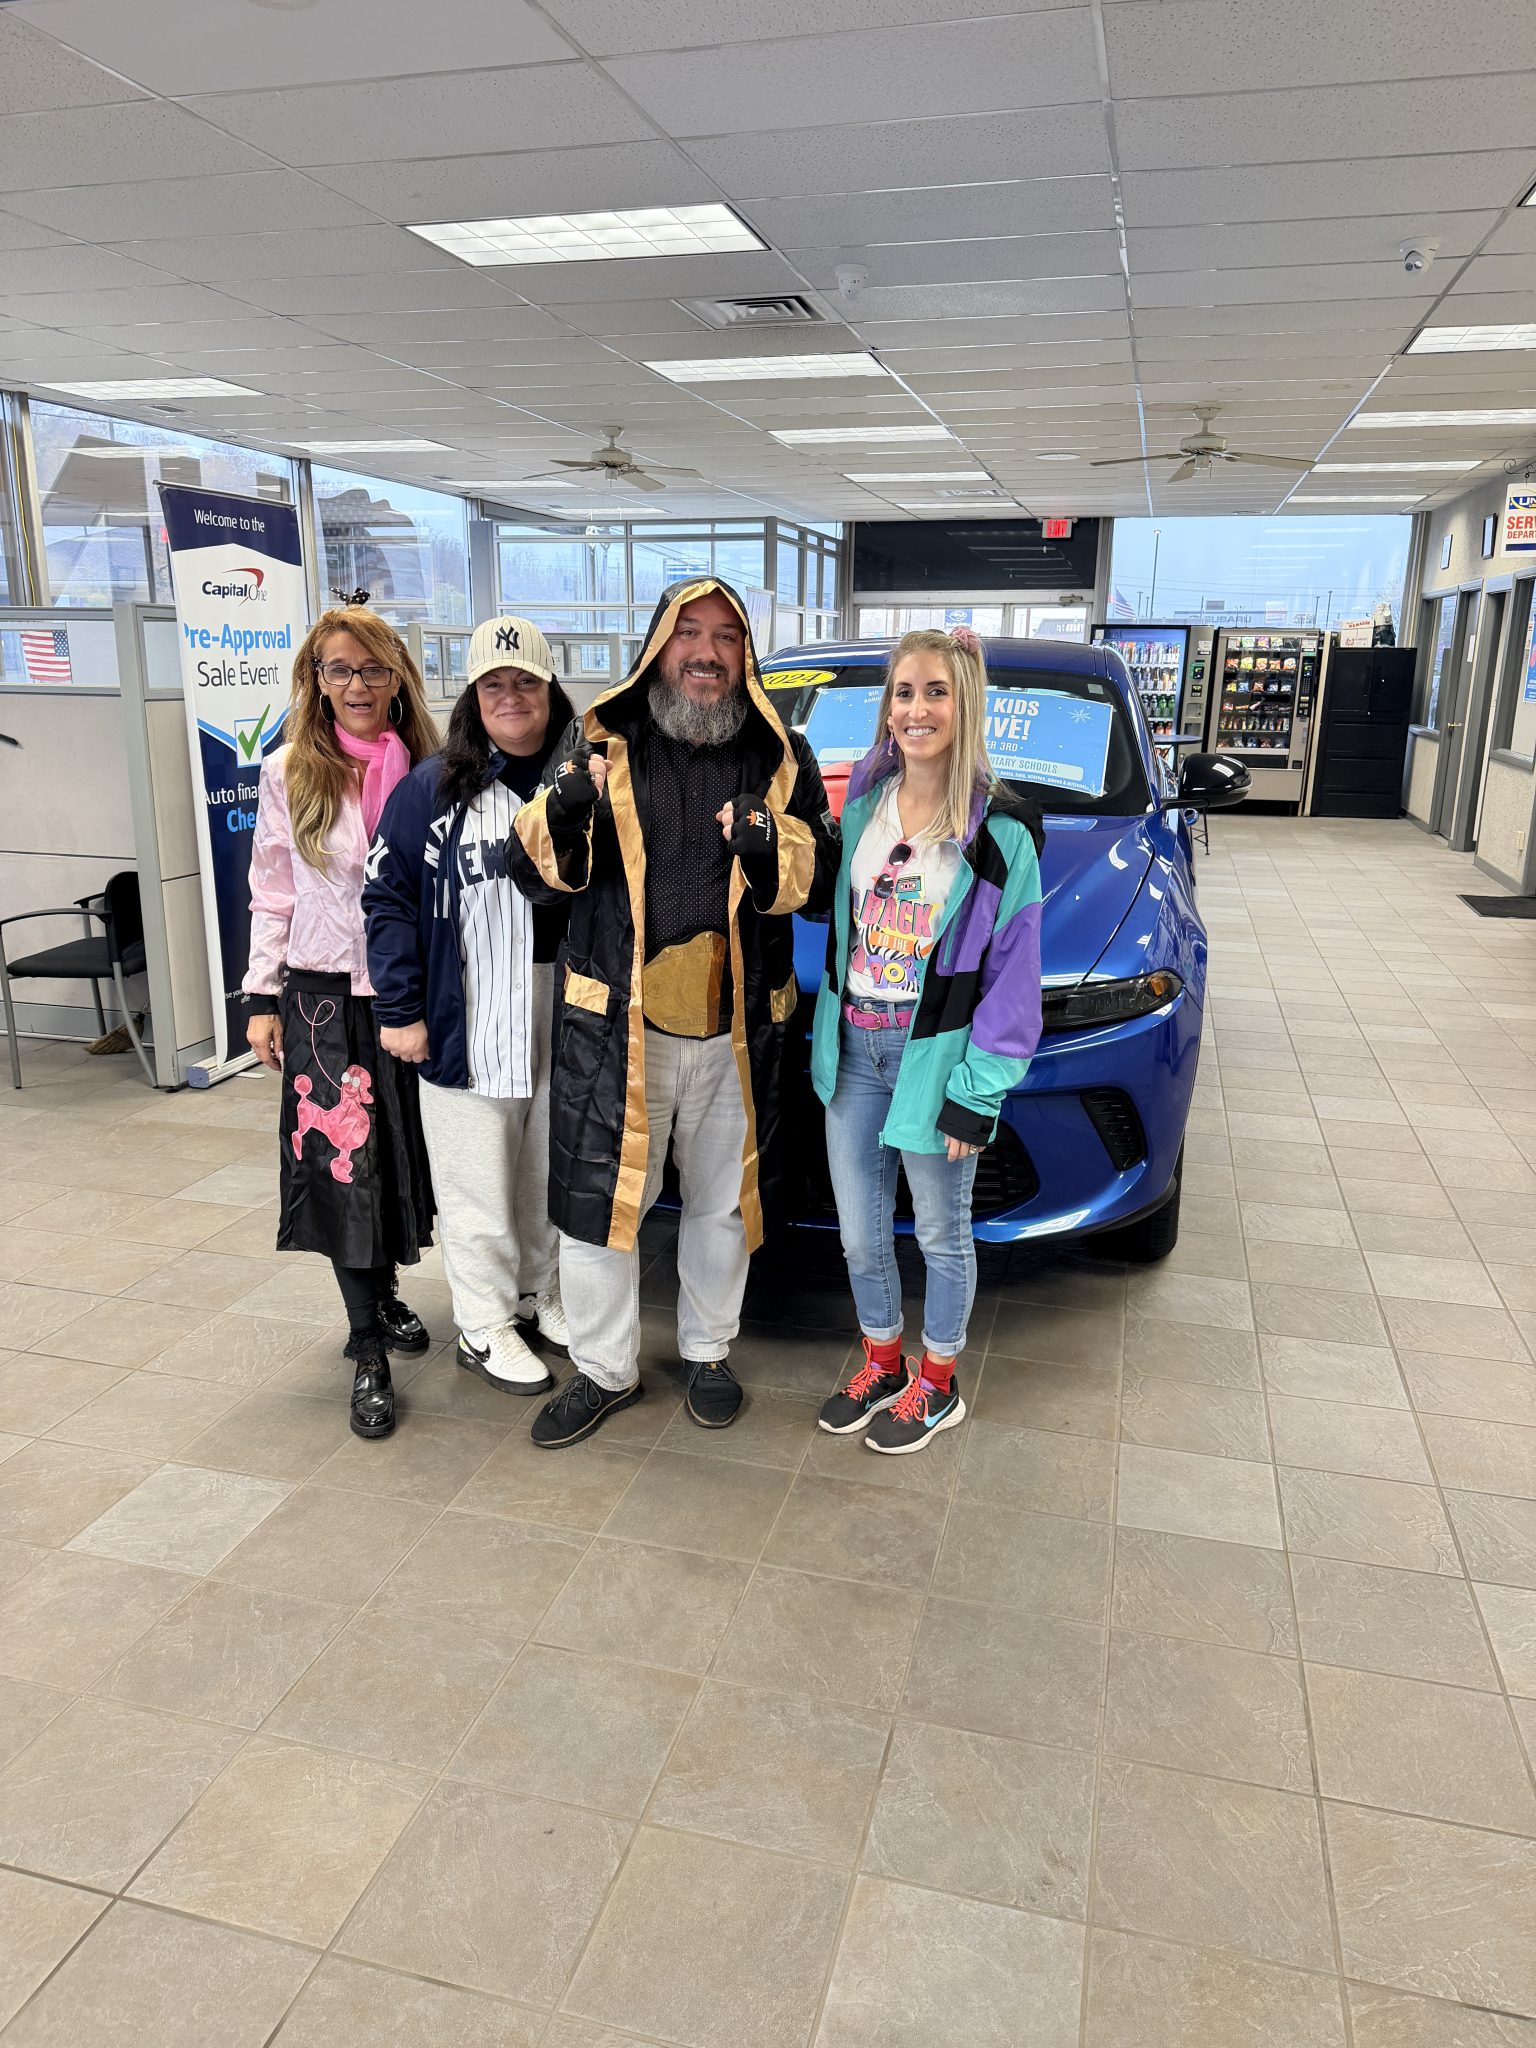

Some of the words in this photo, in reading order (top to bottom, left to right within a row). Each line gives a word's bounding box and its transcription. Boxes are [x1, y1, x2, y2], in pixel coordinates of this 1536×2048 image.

[194, 509, 237, 528] Welcome
[240, 517, 250, 530] to
[251, 517, 265, 532] the
[1046, 519, 1068, 538] EXIT
[1507, 516, 1536, 530] SER
[1507, 531, 1536, 539] DEPAR
[197, 660, 236, 688] Sale
[240, 661, 279, 685] Event
[993, 697, 1040, 717] KIDS
[999, 742, 1018, 752] 3RD
[853, 750, 862, 759] TO
[1019, 759, 1058, 774] SCHOOLS
[204, 787, 235, 804] Auto
[227, 807, 256, 832] Che
[457, 838, 507, 890] EW
[859, 889, 933, 937] BACK
[877, 934, 890, 947] TO
[892, 937, 909, 951] THE
